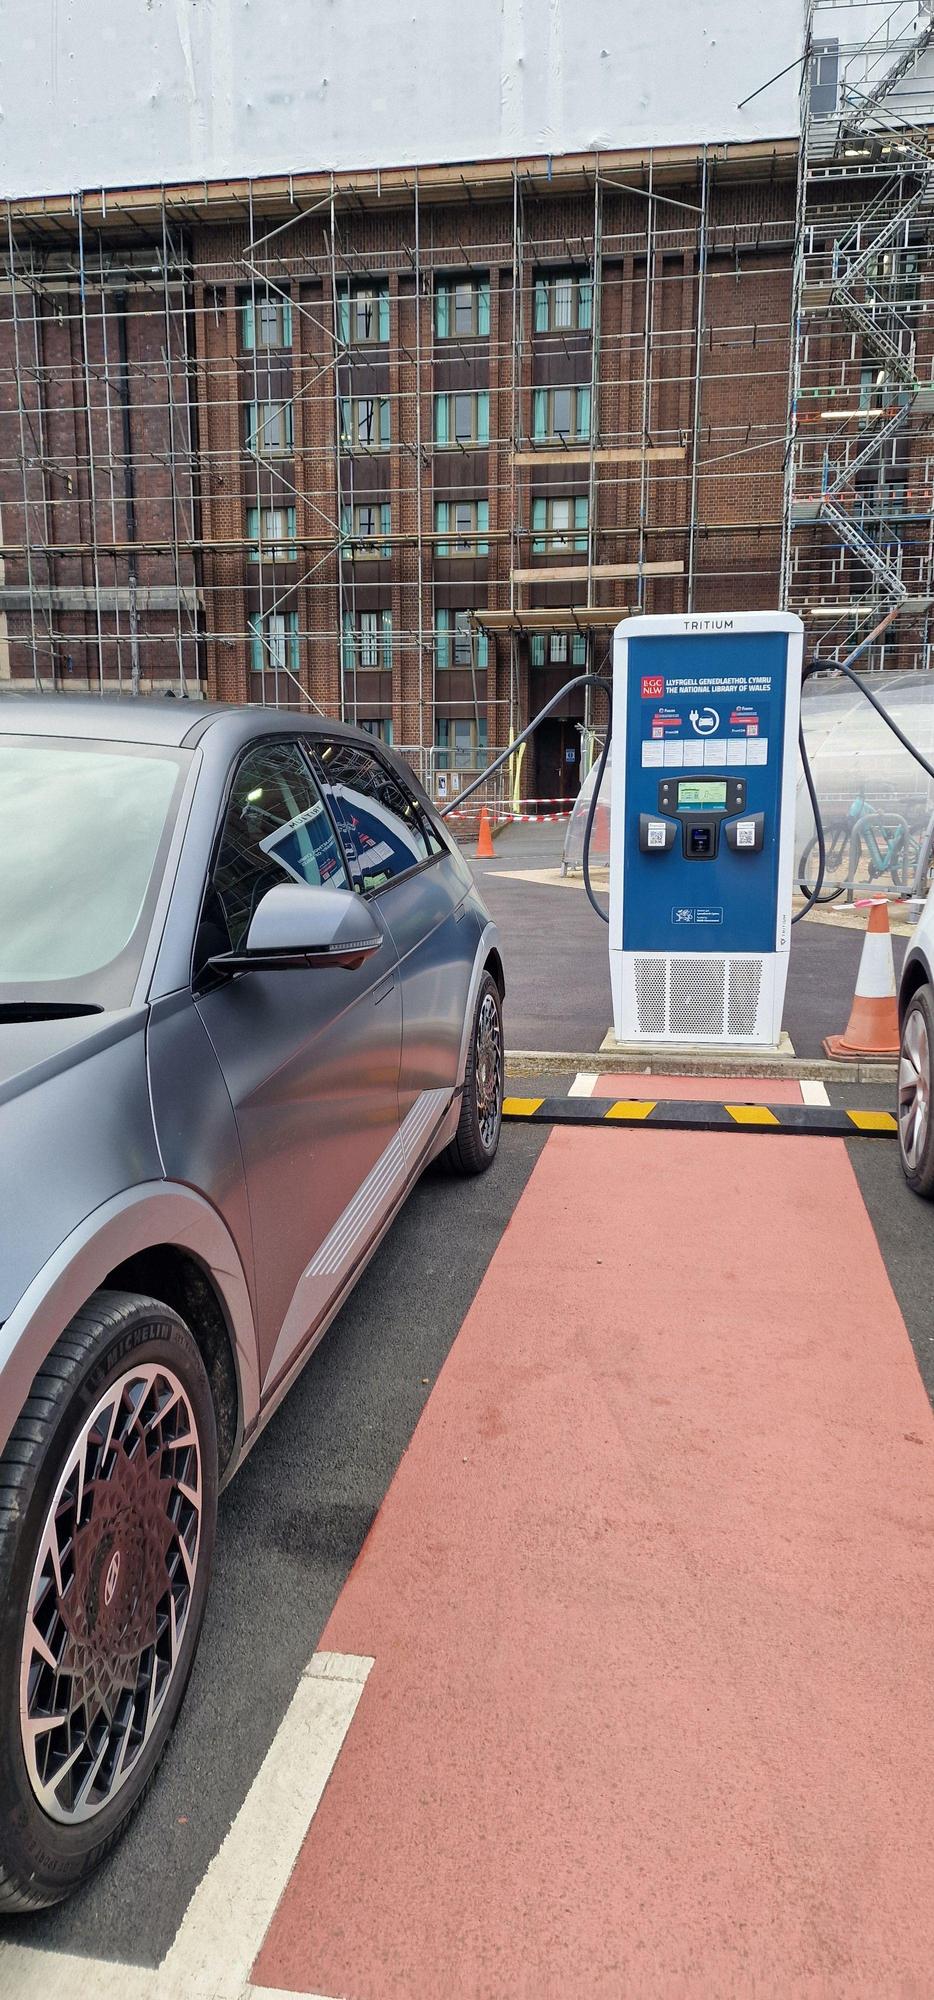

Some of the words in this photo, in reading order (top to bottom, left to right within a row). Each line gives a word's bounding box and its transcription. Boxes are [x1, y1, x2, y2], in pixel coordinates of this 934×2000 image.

[684, 620, 733, 630] TRITIUM
[666, 678, 698, 686] LLYFRGELL
[699, 677, 747, 685] GENEDLAETHOL
[748, 676, 771, 684] CYMRU
[643, 686, 662, 694] NLW
[679, 685, 710, 693] NATIONAL
[712, 684, 738, 692] LIBRARY
[107, 1324, 169, 1369] MICHELIN
